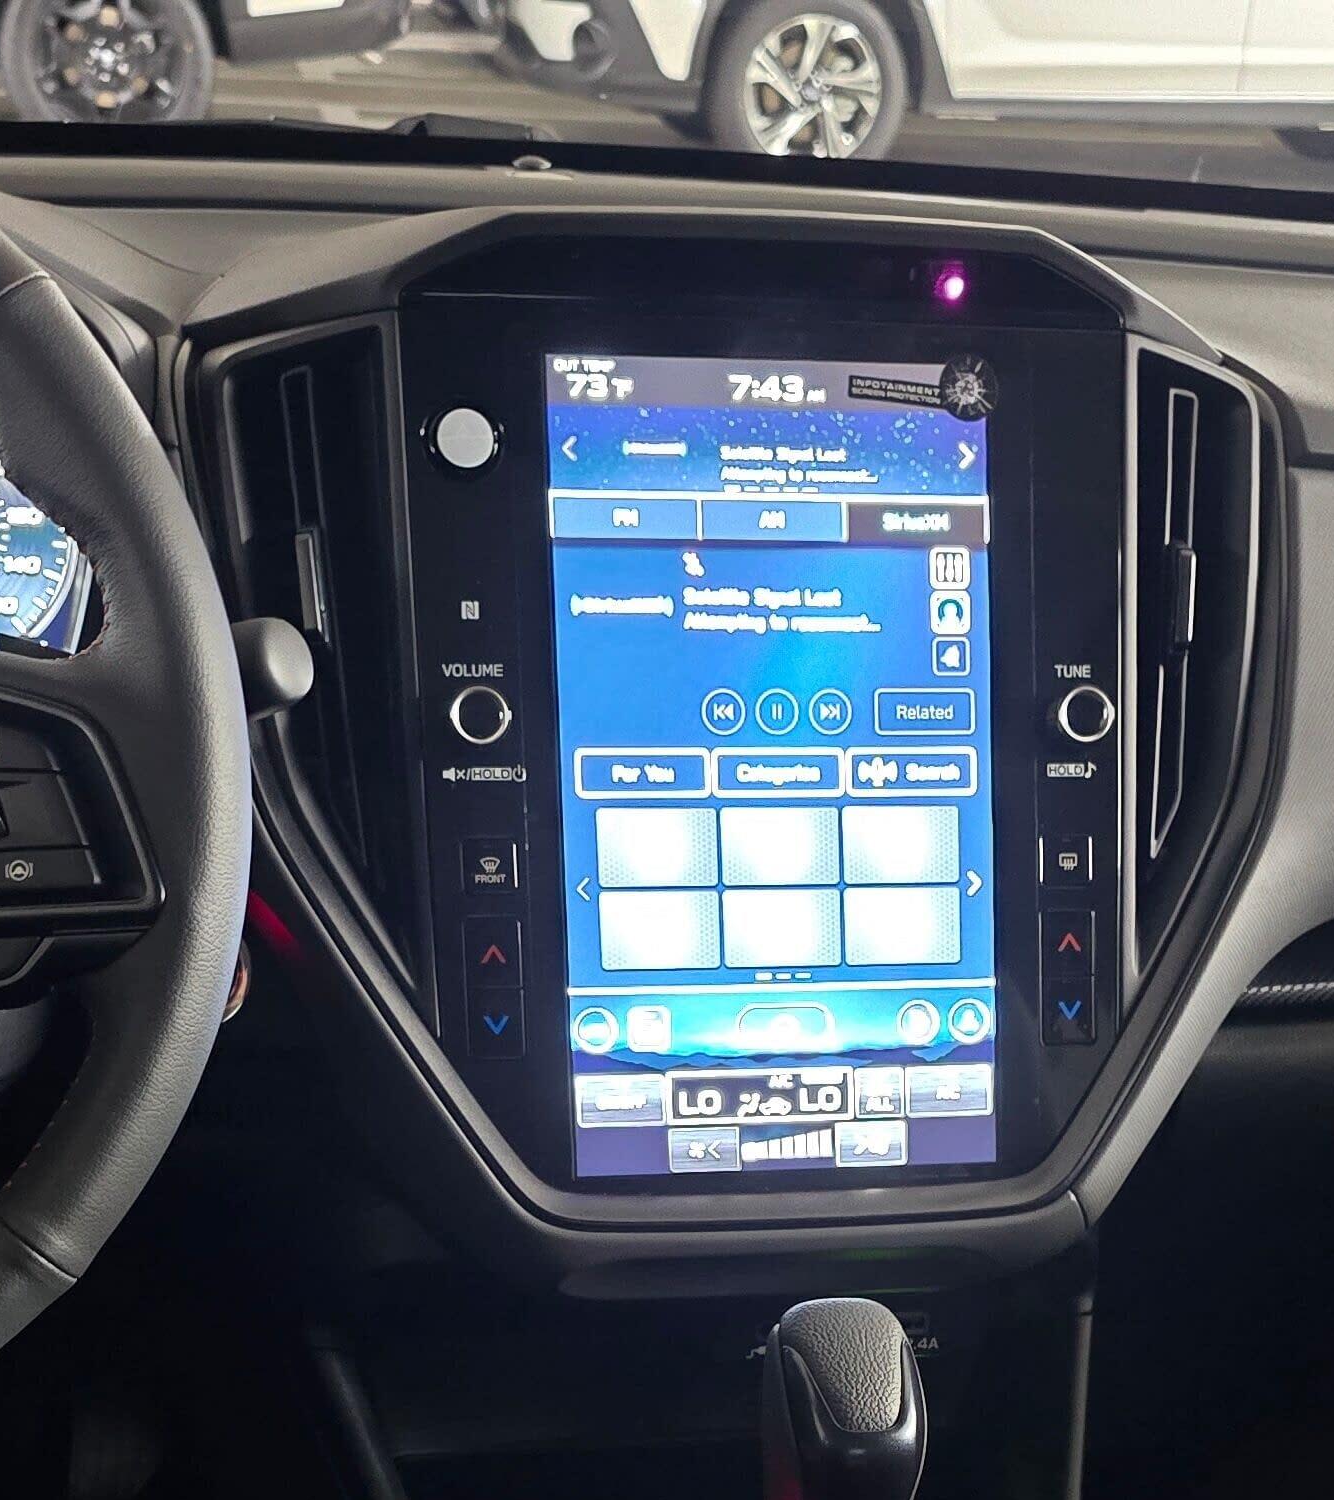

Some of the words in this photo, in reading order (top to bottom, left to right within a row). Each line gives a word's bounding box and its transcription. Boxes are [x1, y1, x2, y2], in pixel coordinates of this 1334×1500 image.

[553, 359, 578, 372] OUT
[582, 360, 616, 372] TEMP
[727, 374, 805, 402] 7:43
[851, 386, 885, 397] SCREEN
[887, 391, 941, 404] PROTECTION
[852, 378, 940, 396] INFOTAINMENT
[612, 507, 640, 527] FM
[758, 509, 786, 529] AM
[882, 511, 951, 531] SiriusXM
[3, 555, 42, 574] 140
[441, 663, 504, 679] VOLUME
[1054, 664, 1092, 679] TUNE
[896, 704, 954, 720] Related
[472, 768, 510, 780] HOLD
[612, 763, 642, 783] For
[644, 763, 675, 783] You
[1048, 764, 1084, 776] HOLD
[474, 873, 507, 884] FRONT
[678, 1089, 722, 1116] LO
[799, 1086, 842, 1112] LO
